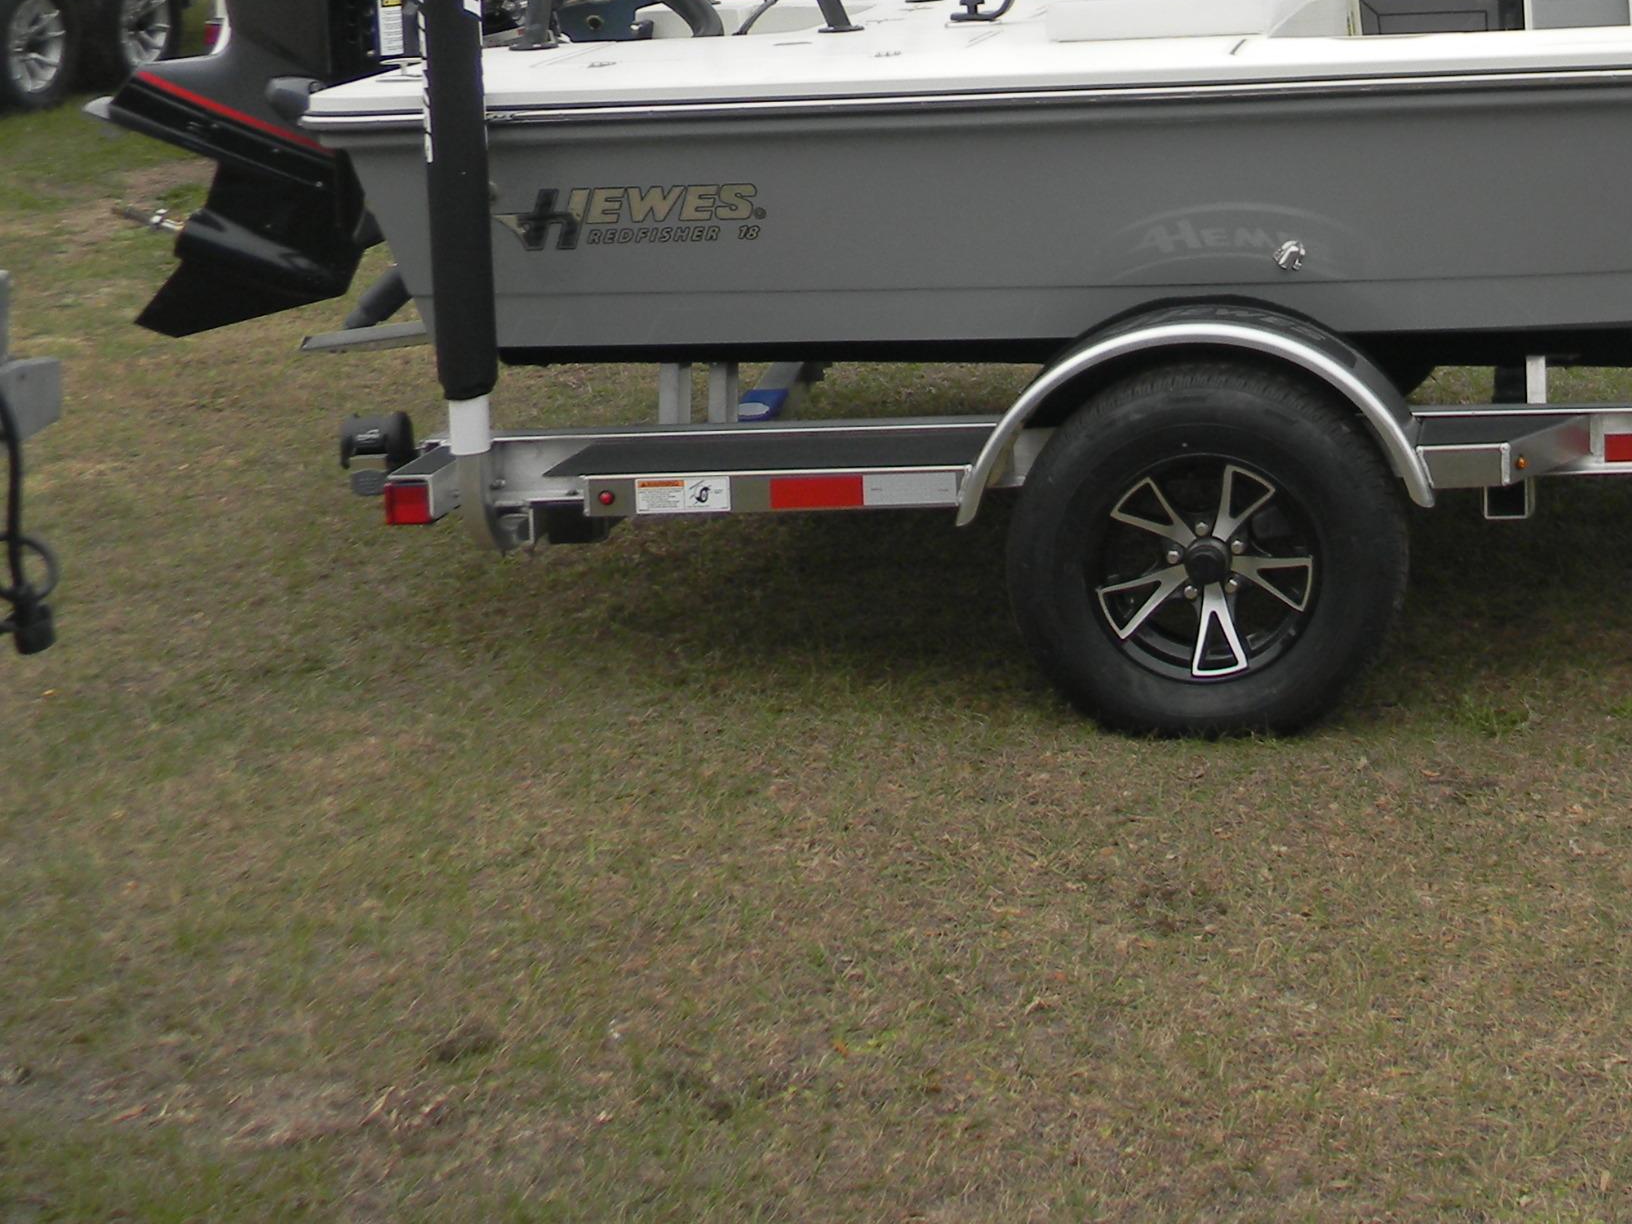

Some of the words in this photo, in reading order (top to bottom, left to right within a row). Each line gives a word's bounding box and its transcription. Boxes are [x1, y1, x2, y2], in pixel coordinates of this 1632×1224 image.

[492, 183, 757, 251] HEWES
[587, 226, 720, 245] REDFISHER
[737, 225, 760, 241] 18
